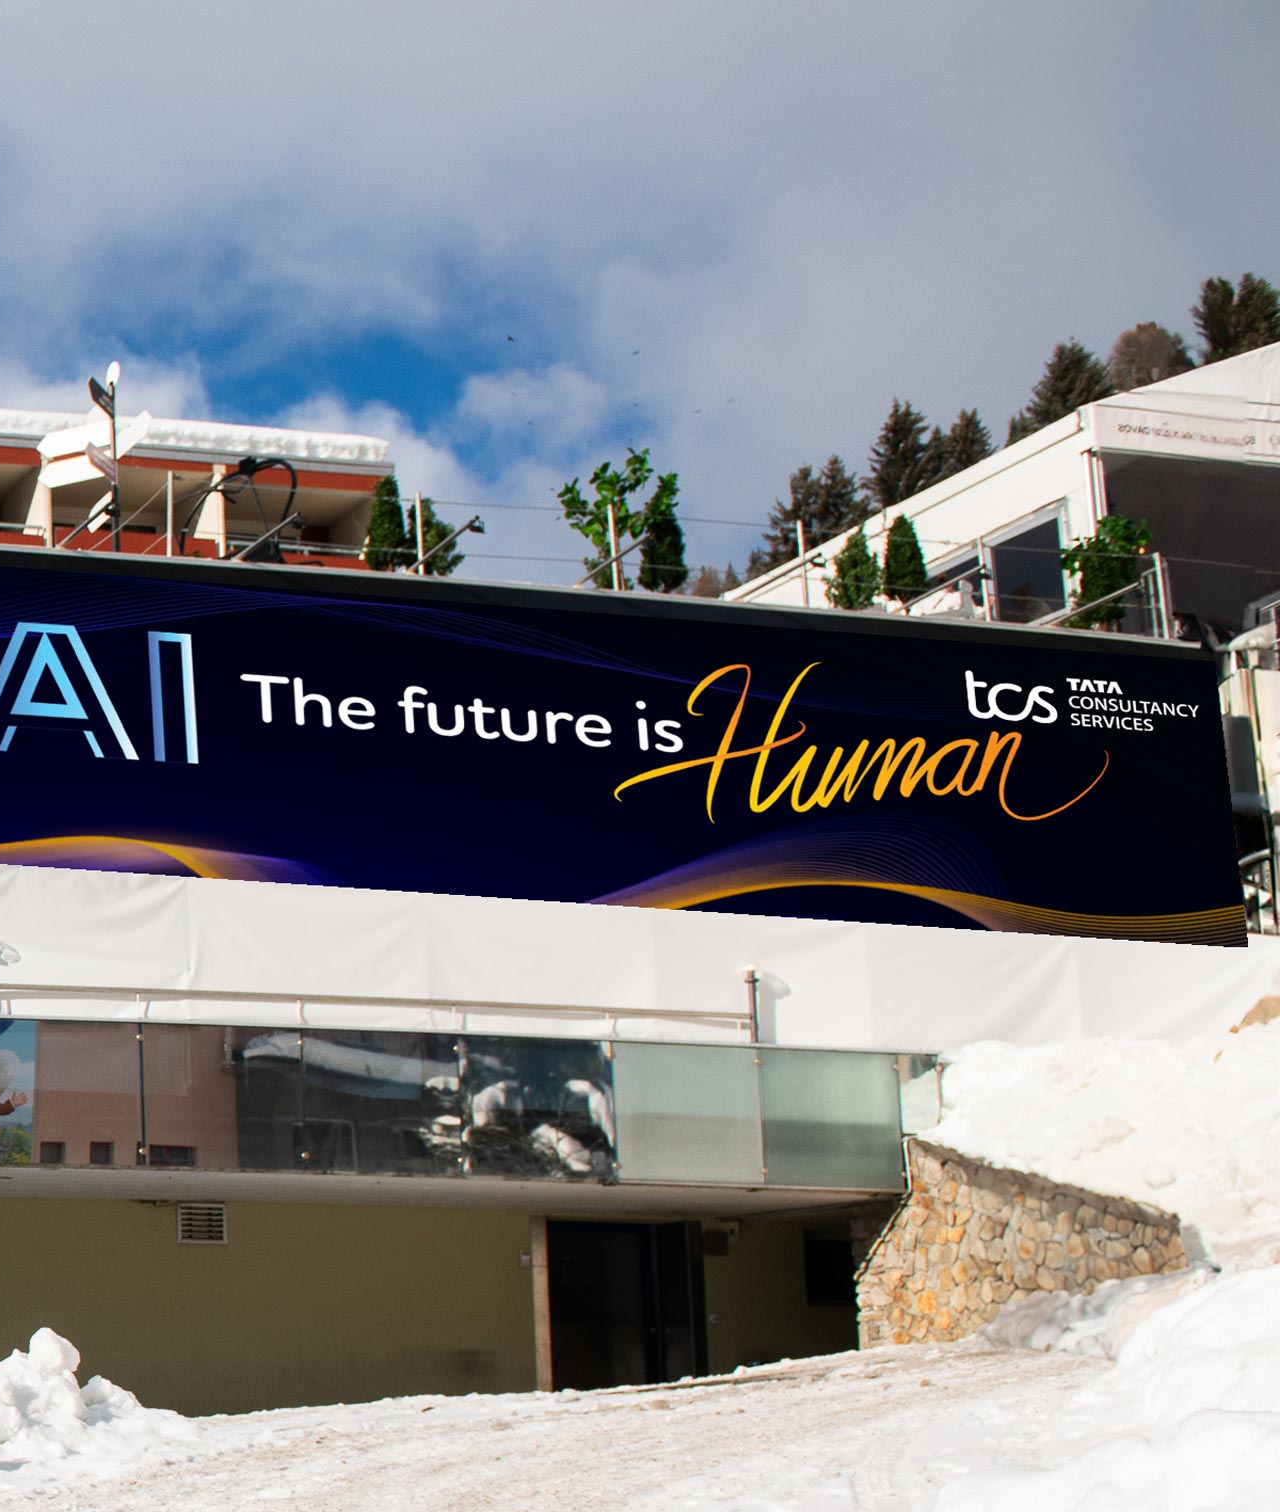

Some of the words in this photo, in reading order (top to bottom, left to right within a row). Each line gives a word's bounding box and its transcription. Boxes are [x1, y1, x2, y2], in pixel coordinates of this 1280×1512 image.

[239, 673, 376, 731] The
[965, 669, 1058, 725] tcs
[1065, 677, 1124, 695] TATA
[1068, 695, 1199, 718] CONSULTANCY
[397, 685, 612, 748] future
[614, 662, 1109, 822] Human
[635, 700, 684, 753] is
[1070, 712, 1154, 732] SERVICES
